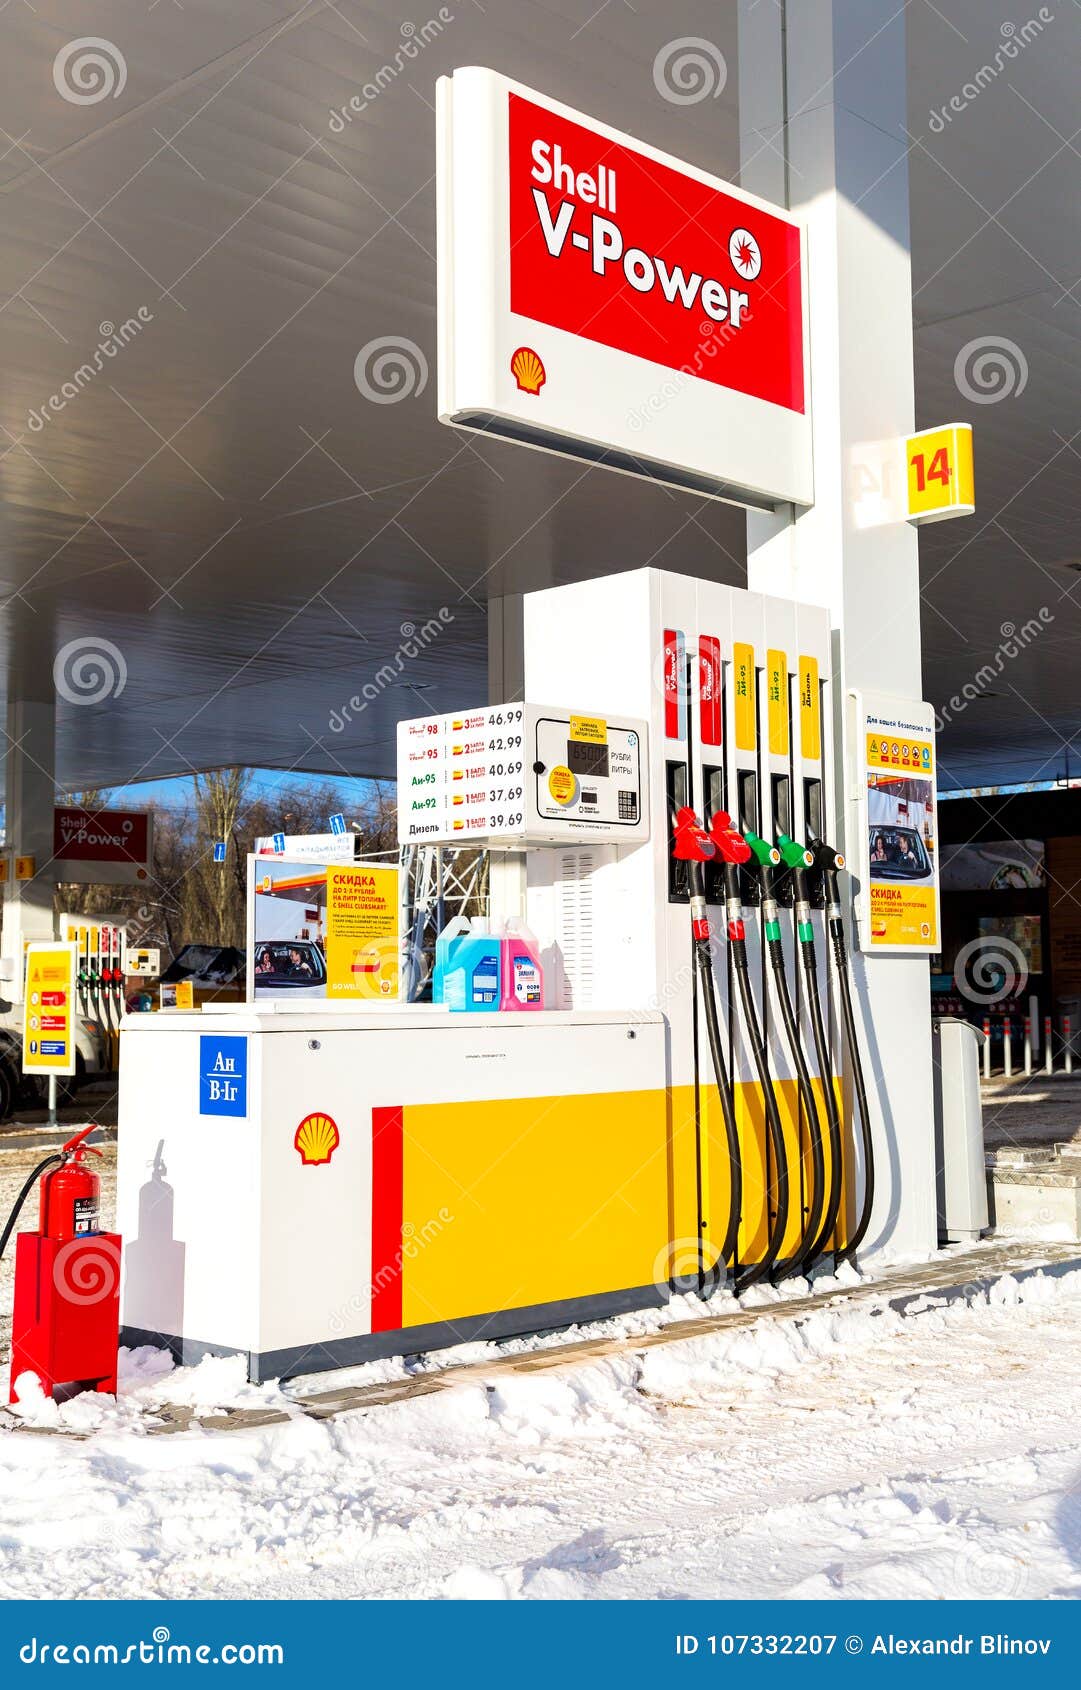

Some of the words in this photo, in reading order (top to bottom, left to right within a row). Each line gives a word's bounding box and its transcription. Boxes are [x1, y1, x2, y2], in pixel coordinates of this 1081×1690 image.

[531, 139, 617, 214] Shell
[531, 186, 749, 328] V-Power
[911, 447, 952, 492] 14
[464, 719, 470, 729] 3
[488, 710, 523, 726] 46,99
[427, 724, 438, 734] 98
[464, 744, 470, 754] 2
[488, 736, 522, 751] 42,99
[427, 749, 438, 759] 95
[610, 752, 632, 761] РУБЛИ
[465, 769, 469, 779] 1
[489, 761, 523, 776] 40,69
[611, 765, 633, 775] ЛИТРЫ
[411, 773, 436, 786] Аи-95
[465, 794, 469, 804] 1
[489, 787, 523, 802] 37,69
[411, 798, 437, 811] Аи-92
[60, 816, 87, 829] Shell
[466, 819, 470, 829] 1
[489, 812, 523, 828] 39,69
[409, 824, 440, 835] Дизель
[60, 828, 129, 847] V-Power
[333, 874, 375, 887] СКИДКА
[871, 888, 902, 900] СКИДКА
[213, 1051, 235, 1072] Ан
